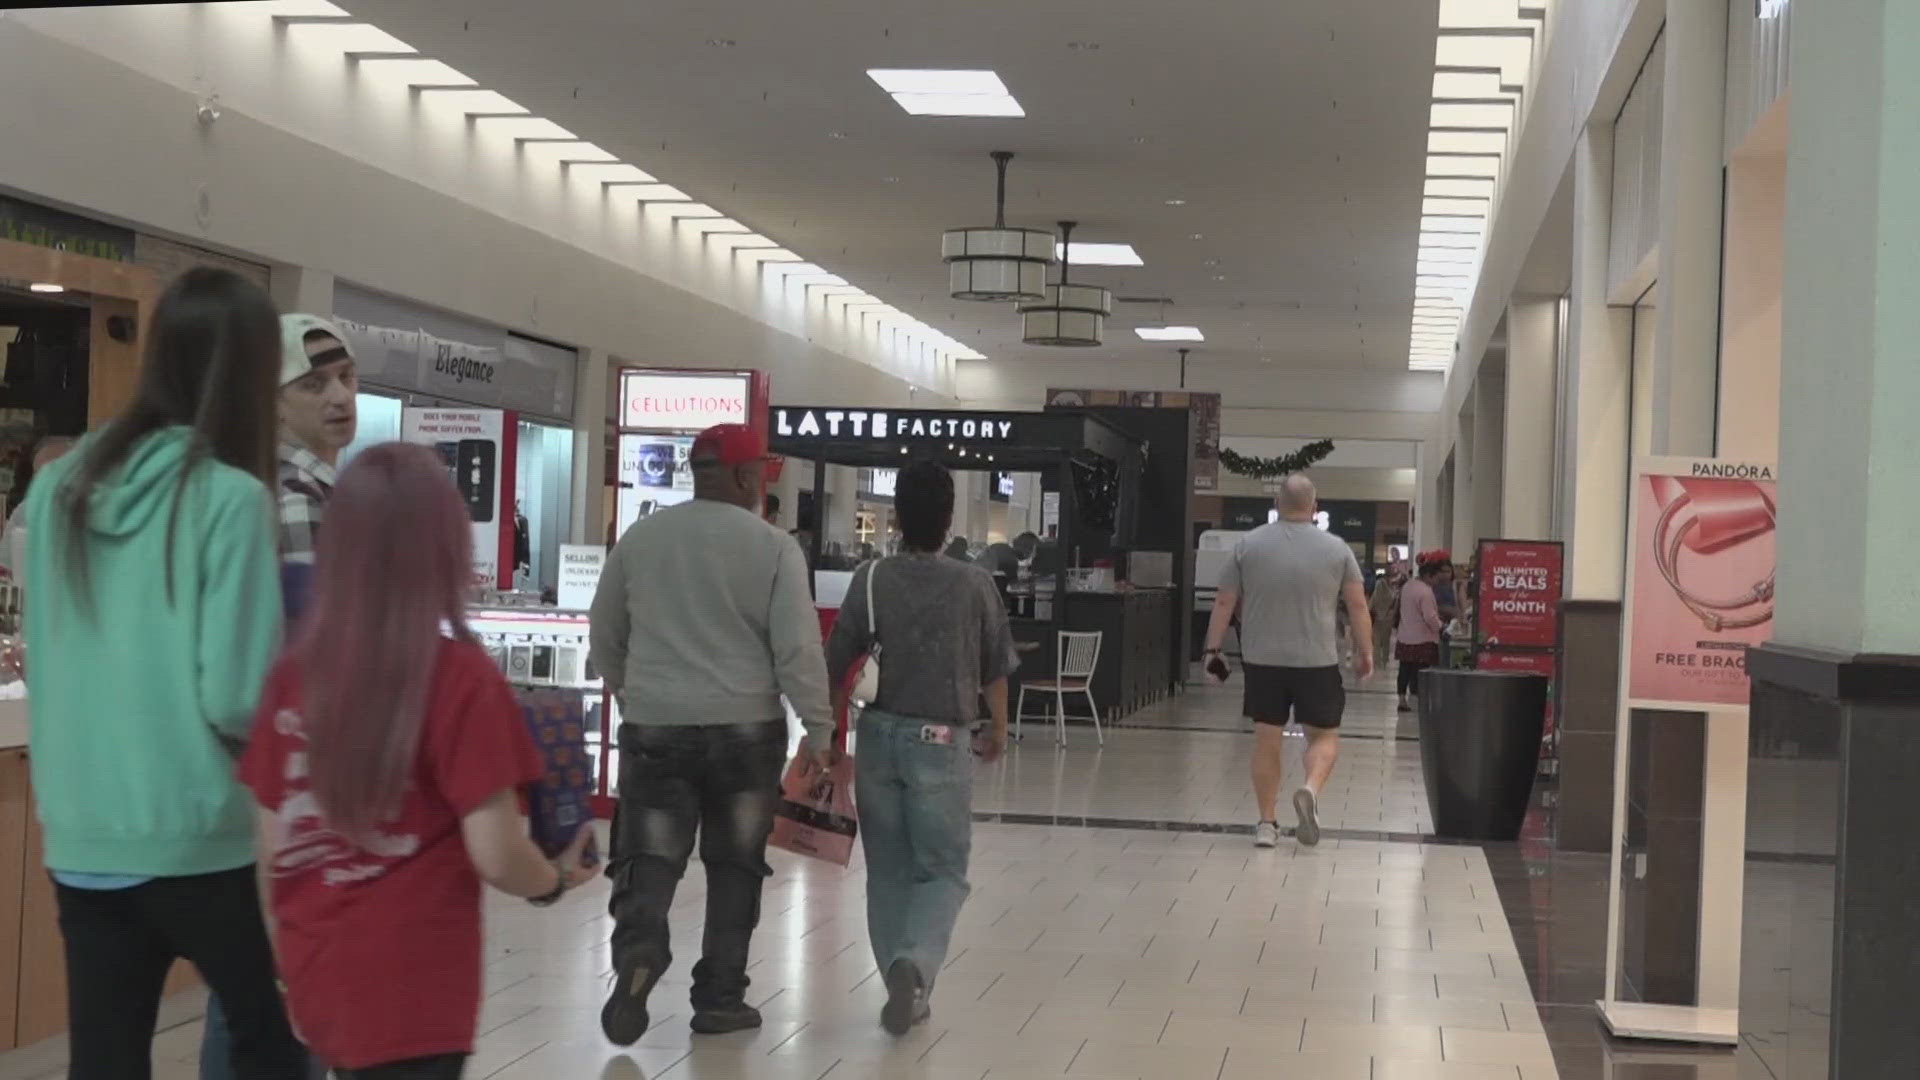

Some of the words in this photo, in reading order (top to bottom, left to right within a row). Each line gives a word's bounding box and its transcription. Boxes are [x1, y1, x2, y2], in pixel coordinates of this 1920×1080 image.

[435, 345, 494, 384] Elegance
[631, 397, 743, 413] CELLUTIONS
[777, 410, 888, 438] LATTE
[896, 418, 1012, 438] FACTORY
[1492, 566, 1548, 576] UNLIMITED
[1493, 575, 1547, 590] DEALS
[1493, 600, 1546, 614] MONTH
[1655, 653, 1697, 667] FREE
